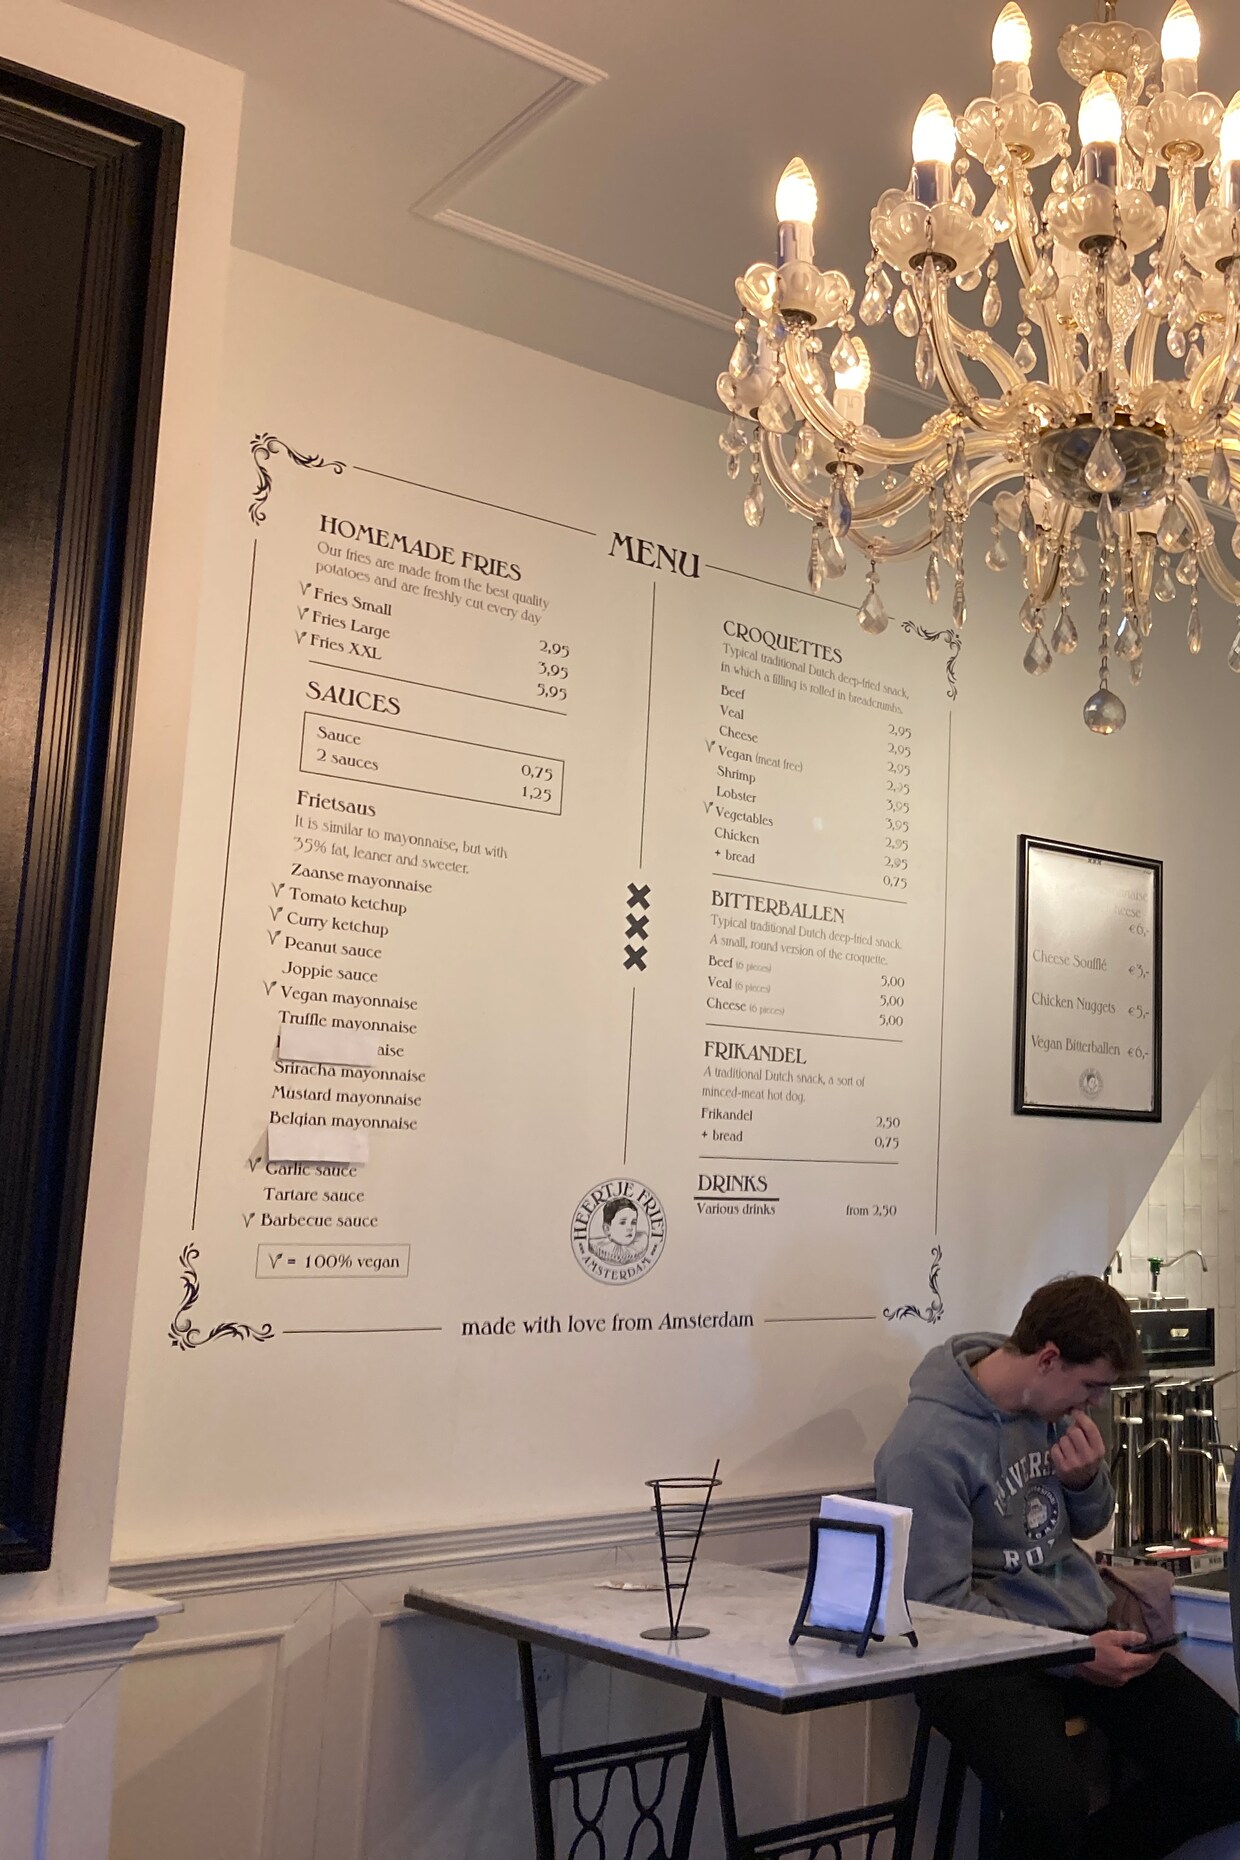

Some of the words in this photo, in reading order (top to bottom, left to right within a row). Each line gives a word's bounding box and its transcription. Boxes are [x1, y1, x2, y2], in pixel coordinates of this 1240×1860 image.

[319, 514, 455, 565] HOMEMADE
[461, 551, 521, 581] FRIES
[607, 531, 700, 578] MENU
[317, 541, 342, 558] Our
[345, 547, 371, 565] fries
[374, 558, 394, 570] are
[398, 563, 431, 580] made
[434, 569, 460, 587] from
[463, 577, 482, 592] the
[485, 582, 509, 599] best
[512, 592, 549, 611] quality
[315, 562, 370, 582] potatoes
[373, 575, 397, 589] and
[400, 581, 420, 595] are
[423, 584, 462, 607] freshly
[486, 602, 518, 620] every
[520, 609, 541, 626] day
[314, 587, 348, 606] Fries
[351, 596, 391, 616] Small
[539, 640, 569, 658] 2,95
[312, 610, 346, 629] Fries
[350, 618, 390, 639] Large
[538, 661, 568, 679] 3,95
[723, 620, 842, 663] CROQUETTES
[310, 633, 344, 652] Fries
[348, 641, 381, 660] XXL
[537, 683, 567, 701] 5,95
[722, 642, 758, 661] Typical
[760, 652, 806, 673] traditional
[808, 663, 835, 680] Dutch
[837, 671, 880, 691] deep-fried
[733, 664, 761, 680] which
[772, 673, 797, 691] filling
[809, 684, 835, 698] rolled
[305, 680, 400, 715] SAUCES
[719, 704, 744, 720] Veal
[720, 684, 745, 699] Beef
[888, 723, 911, 739] 2,95
[718, 724, 758, 743] Cheese
[316, 726, 360, 745] Sauce
[521, 764, 552, 781] 0,75
[718, 744, 752, 762] Vegan
[316, 748, 326, 762] 2
[330, 754, 378, 770] sauces
[522, 785, 551, 802] 1,25
[716, 765, 755, 785] Shrimp
[297, 789, 375, 816] Frietsaus
[716, 785, 756, 803] Lobster
[715, 805, 773, 826] Vegetables
[293, 836, 327, 854] 35%
[353, 845, 392, 863] leaner
[395, 853, 418, 867] and
[321, 820, 363, 837] similar
[383, 831, 458, 853] mayonnaise,
[484, 845, 507, 859] with
[714, 826, 759, 844] Chicken
[884, 855, 908, 870] 2,95
[291, 863, 344, 881] Zaanse
[347, 873, 432, 893] mayonnaise
[725, 848, 755, 864] bread
[882, 875, 907, 889] 0,75
[289, 886, 346, 906] Tomato
[350, 894, 407, 916] ketchup
[711, 889, 844, 923] BITTERBALLEN
[286, 911, 328, 931] Curry
[331, 916, 388, 938] ketchup
[710, 913, 747, 930] Typical
[750, 919, 796, 935] traditional
[798, 925, 826, 940] Dutch
[828, 929, 872, 946] deep-fried
[284, 935, 337, 954] Peanut
[340, 945, 381, 958] sauce
[719, 936, 747, 950] small,
[750, 940, 778, 952] round
[780, 943, 814, 956] version
[828, 947, 843, 960] the
[281, 961, 333, 979] Joppie
[336, 969, 377, 982] sauce
[708, 954, 733, 968] Beef
[1032, 949, 1070, 966] Cheese
[1073, 955, 1107, 971] Soufflé
[707, 975, 732, 989] Veal
[280, 985, 328, 1004] Vegan
[332, 993, 417, 1010] mayonnaise
[706, 996, 746, 1011] Cheese
[1031, 991, 1073, 1009] Chicken
[1076, 997, 1116, 1015] Nuggets
[278, 1010, 327, 1027] Truffle
[331, 1018, 416, 1034] mayonnaise
[704, 1040, 806, 1064] FRIKANDEL
[1031, 1034, 1062, 1053] Vegan
[1065, 1037, 1121, 1056] Bitterballen
[273, 1059, 336, 1077] Sriracha
[340, 1064, 426, 1085] mayonnaise
[714, 1066, 762, 1080] traditional
[764, 1068, 793, 1083] Dutch
[271, 1085, 331, 1101] Mustard
[335, 1092, 421, 1107] mayonnaise
[701, 1085, 764, 1099] minced-meat
[269, 1110, 326, 1127] Belgian
[331, 1116, 417, 1130] mayonnaise
[701, 1107, 752, 1121] Frikandel
[712, 1128, 743, 1142] bread
[265, 1161, 311, 1176] Garlic
[314, 1166, 357, 1177] sauce
[263, 1187, 318, 1201] Tartare
[322, 1192, 364, 1202] sauce
[697, 1174, 767, 1193] DRINKS
[260, 1212, 332, 1226] Barbecue
[336, 1217, 377, 1227] sauce
[574, 1181, 634, 1241] HEERTJE
[637, 1188, 665, 1242] FRIET
[696, 1202, 739, 1214] Various
[742, 1203, 775, 1215] drinks
[846, 1204, 869, 1216] from
[306, 1254, 352, 1268] 100%
[357, 1258, 399, 1271] vegan
[582, 1256, 651, 1280] AMSTERDAM
[461, 1316, 515, 1335] made
[522, 1315, 561, 1333] with
[567, 1315, 605, 1332] love
[612, 1313, 652, 1331] from
[658, 1310, 753, 1330] Amsterdam
